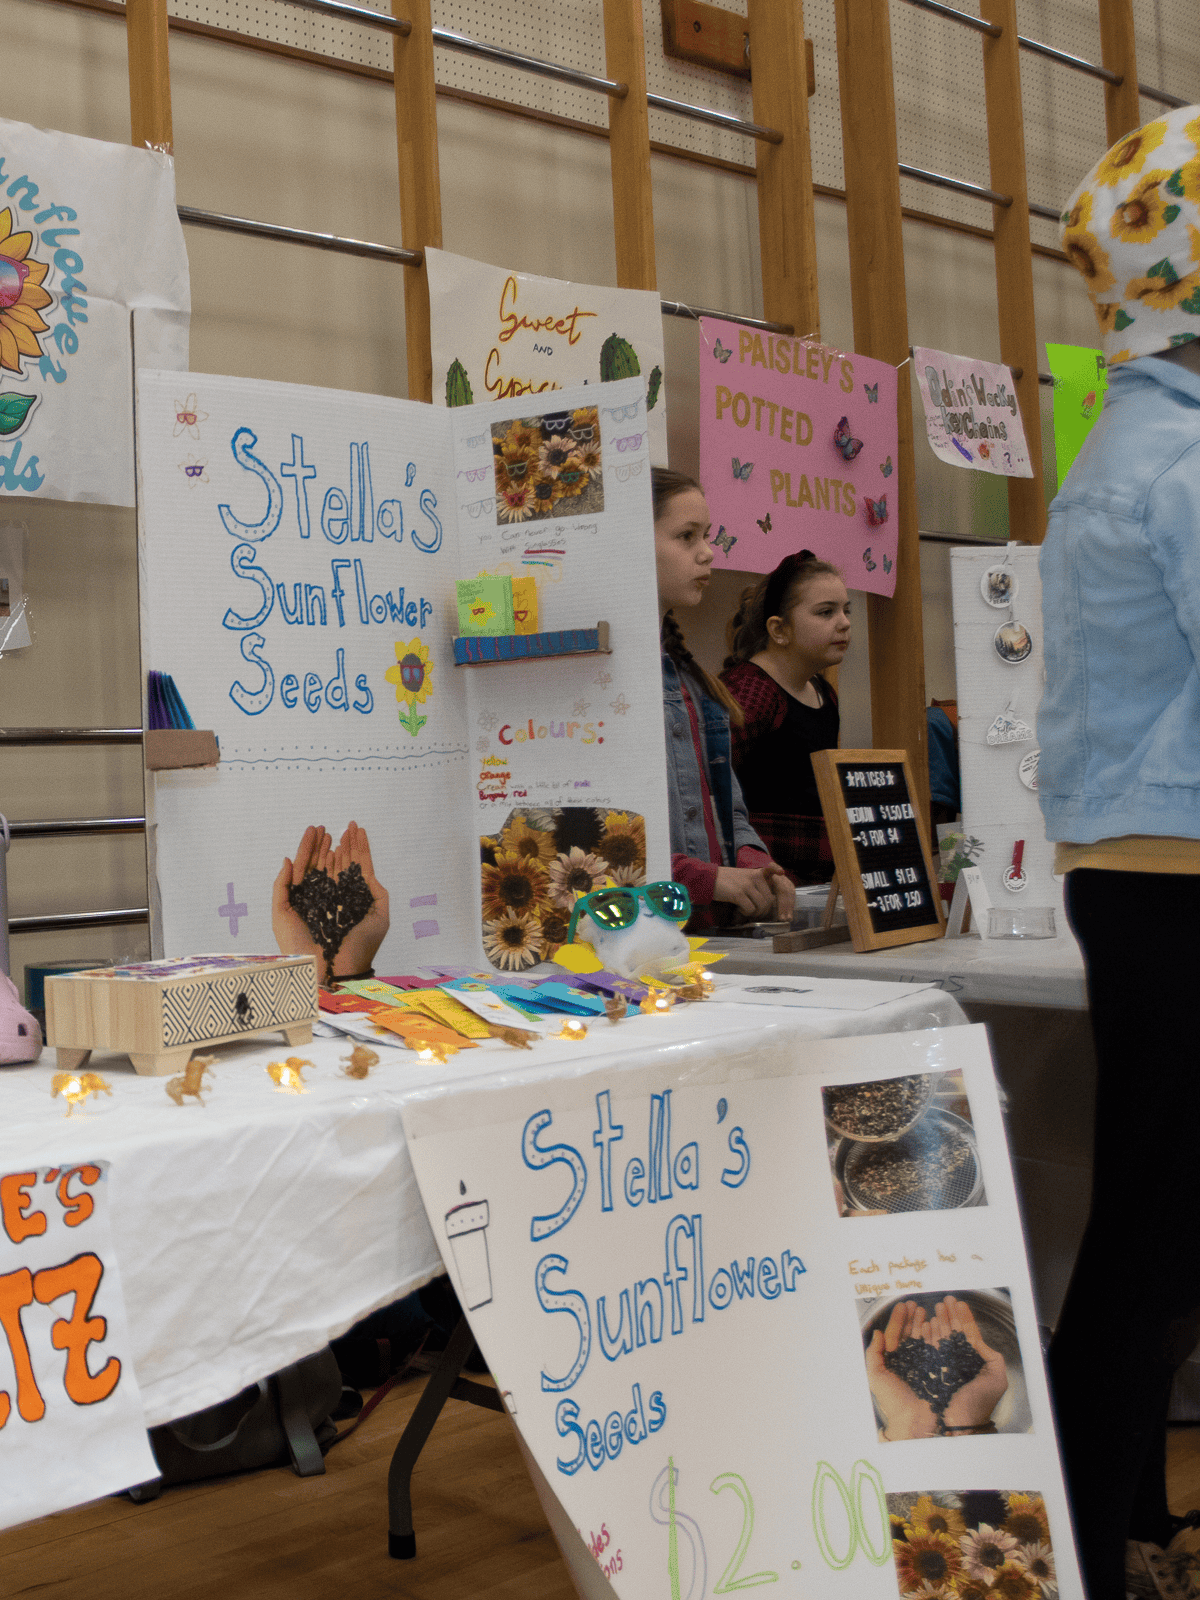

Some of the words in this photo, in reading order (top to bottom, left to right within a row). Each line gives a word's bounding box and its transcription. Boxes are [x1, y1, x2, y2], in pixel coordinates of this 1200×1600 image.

[498, 276, 598, 346] Sweet
[533, 344, 554, 356] AND
[739, 329, 855, 393] PAISLEY'S
[924, 366, 974, 408] Odin's
[715, 385, 814, 447] POTTED
[218, 426, 442, 554] Stella's
[769, 469, 857, 518] PLANTS
[554, 524, 566, 537] go
[221, 543, 433, 631] Sunflower
[229, 632, 374, 716] Seeds
[498, 718, 605, 746] Colours:
[854, 771, 886, 788] PRICES
[901, 803, 915, 820] EA
[860, 830, 869, 847] 3
[869, 829, 886, 846] FOR
[887, 827, 900, 844] $4
[861, 870, 890, 890] SMALL
[895, 868, 905, 885] $1
[905, 867, 918, 883] EA
[877, 895, 886, 912] 3
[886, 894, 902, 911] FOR
[521, 1088, 751, 1242] Stella's
[848, 1259, 881, 1276] Each
[936, 1249, 957, 1263] has
[970, 1253, 984, 1262] a
[535, 1213, 807, 1393] Sunflower
[555, 1382, 667, 1477] Seeds
[649, 1456, 895, 1600] $2.00
